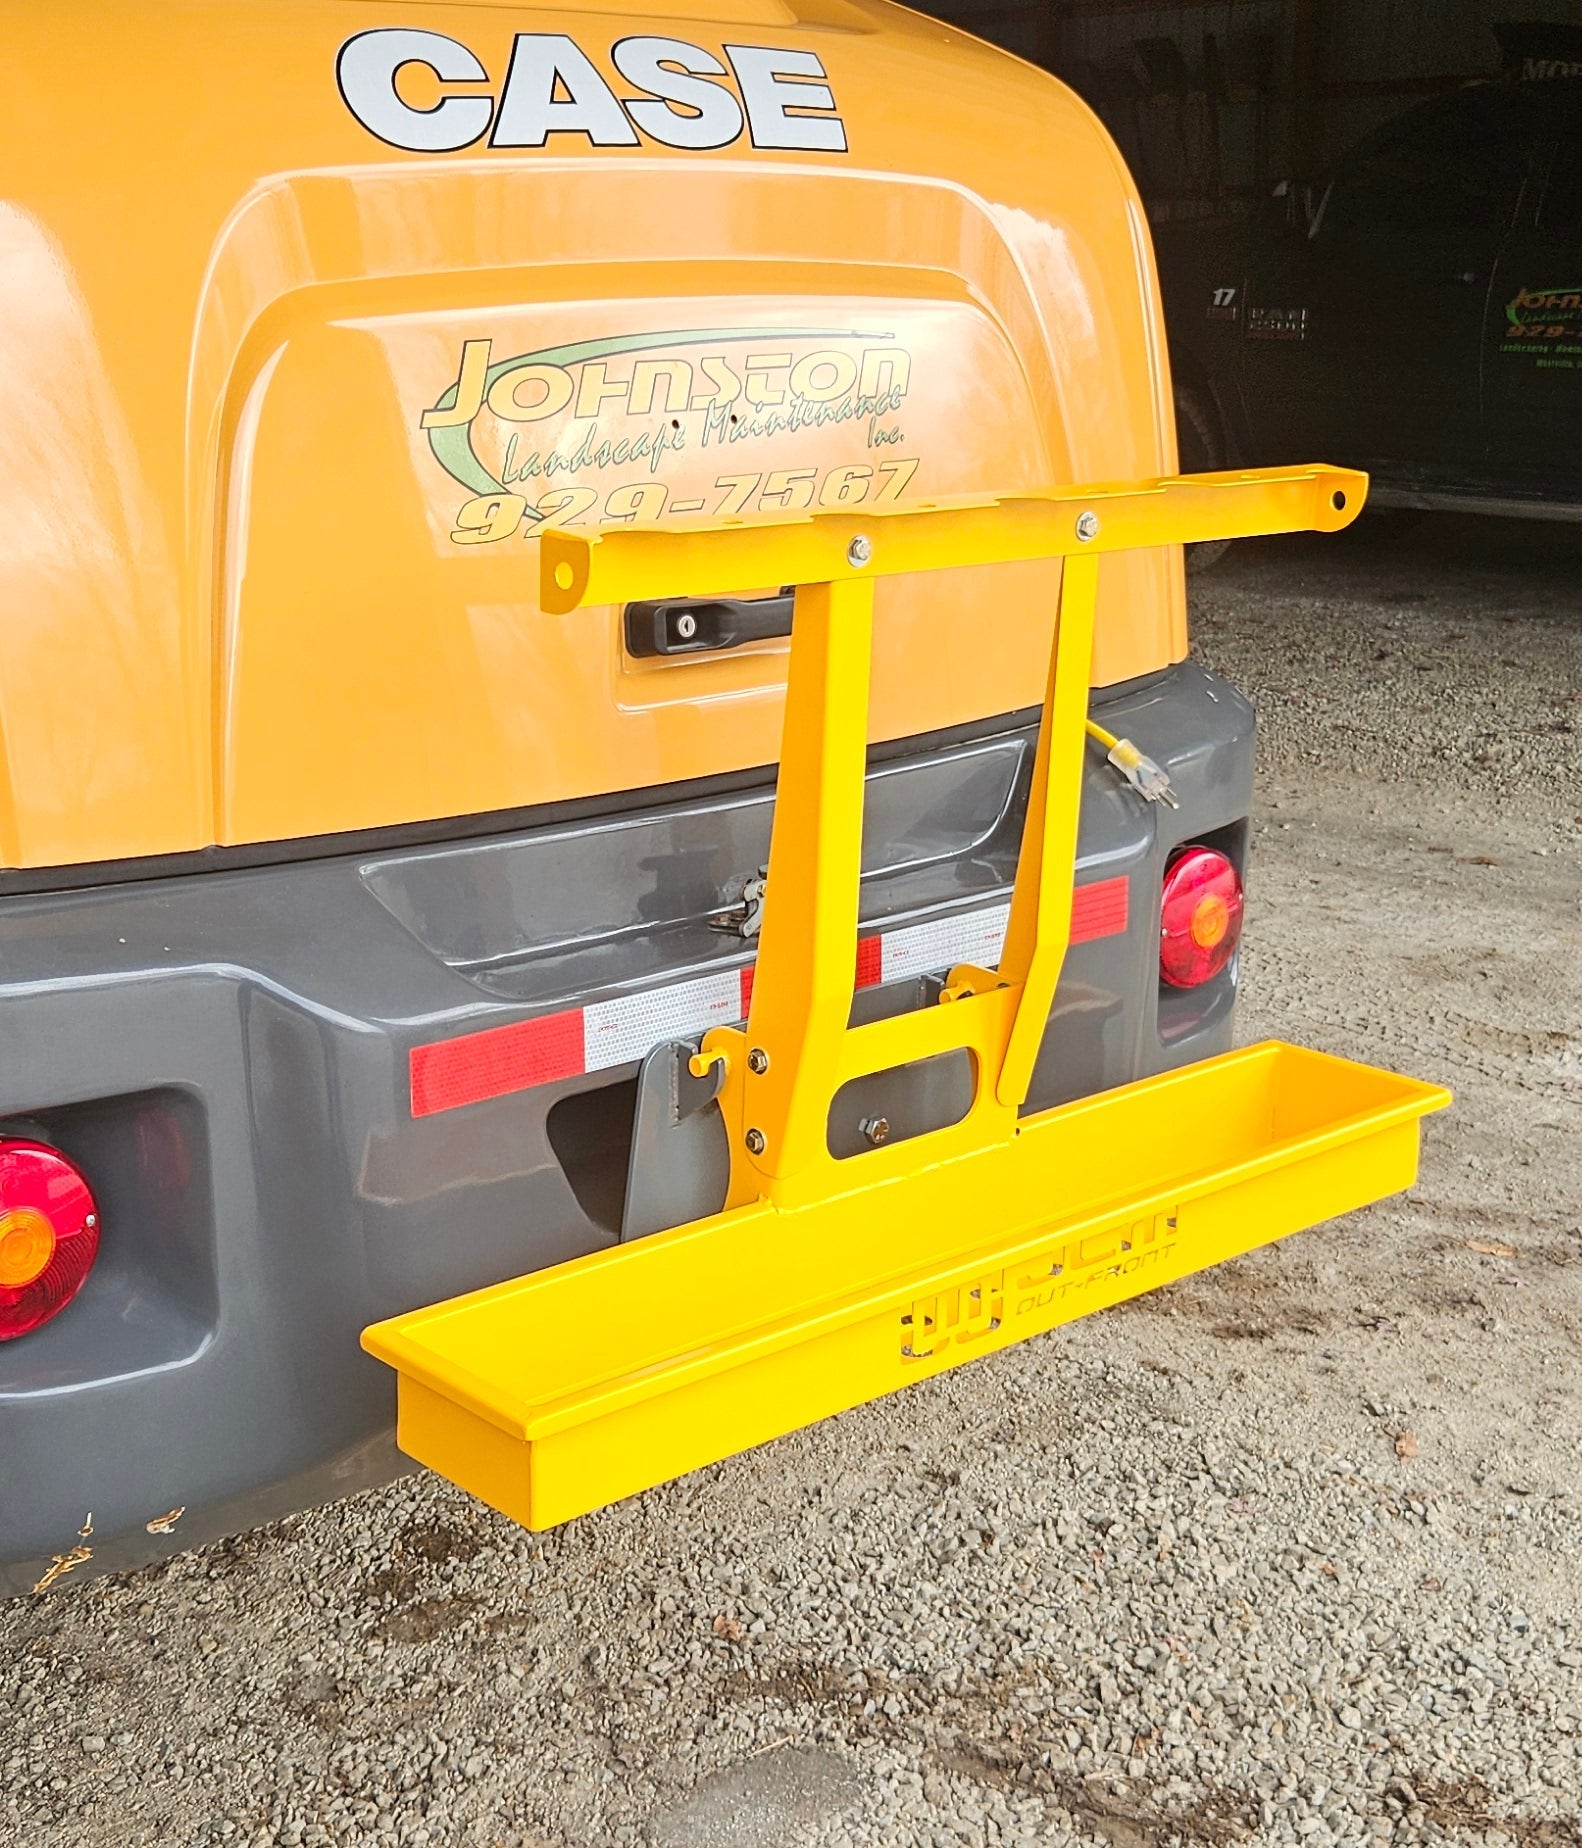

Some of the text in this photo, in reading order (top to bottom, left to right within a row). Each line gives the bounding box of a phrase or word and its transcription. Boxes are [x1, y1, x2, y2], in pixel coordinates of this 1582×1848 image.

[335, 28, 848, 153] CASE
[1212, 288, 1236, 307] 17
[502, 385, 902, 485] Landscape Maintenance
[868, 417, 905, 448] Inc.
[450, 458, 920, 545] 929-7567
